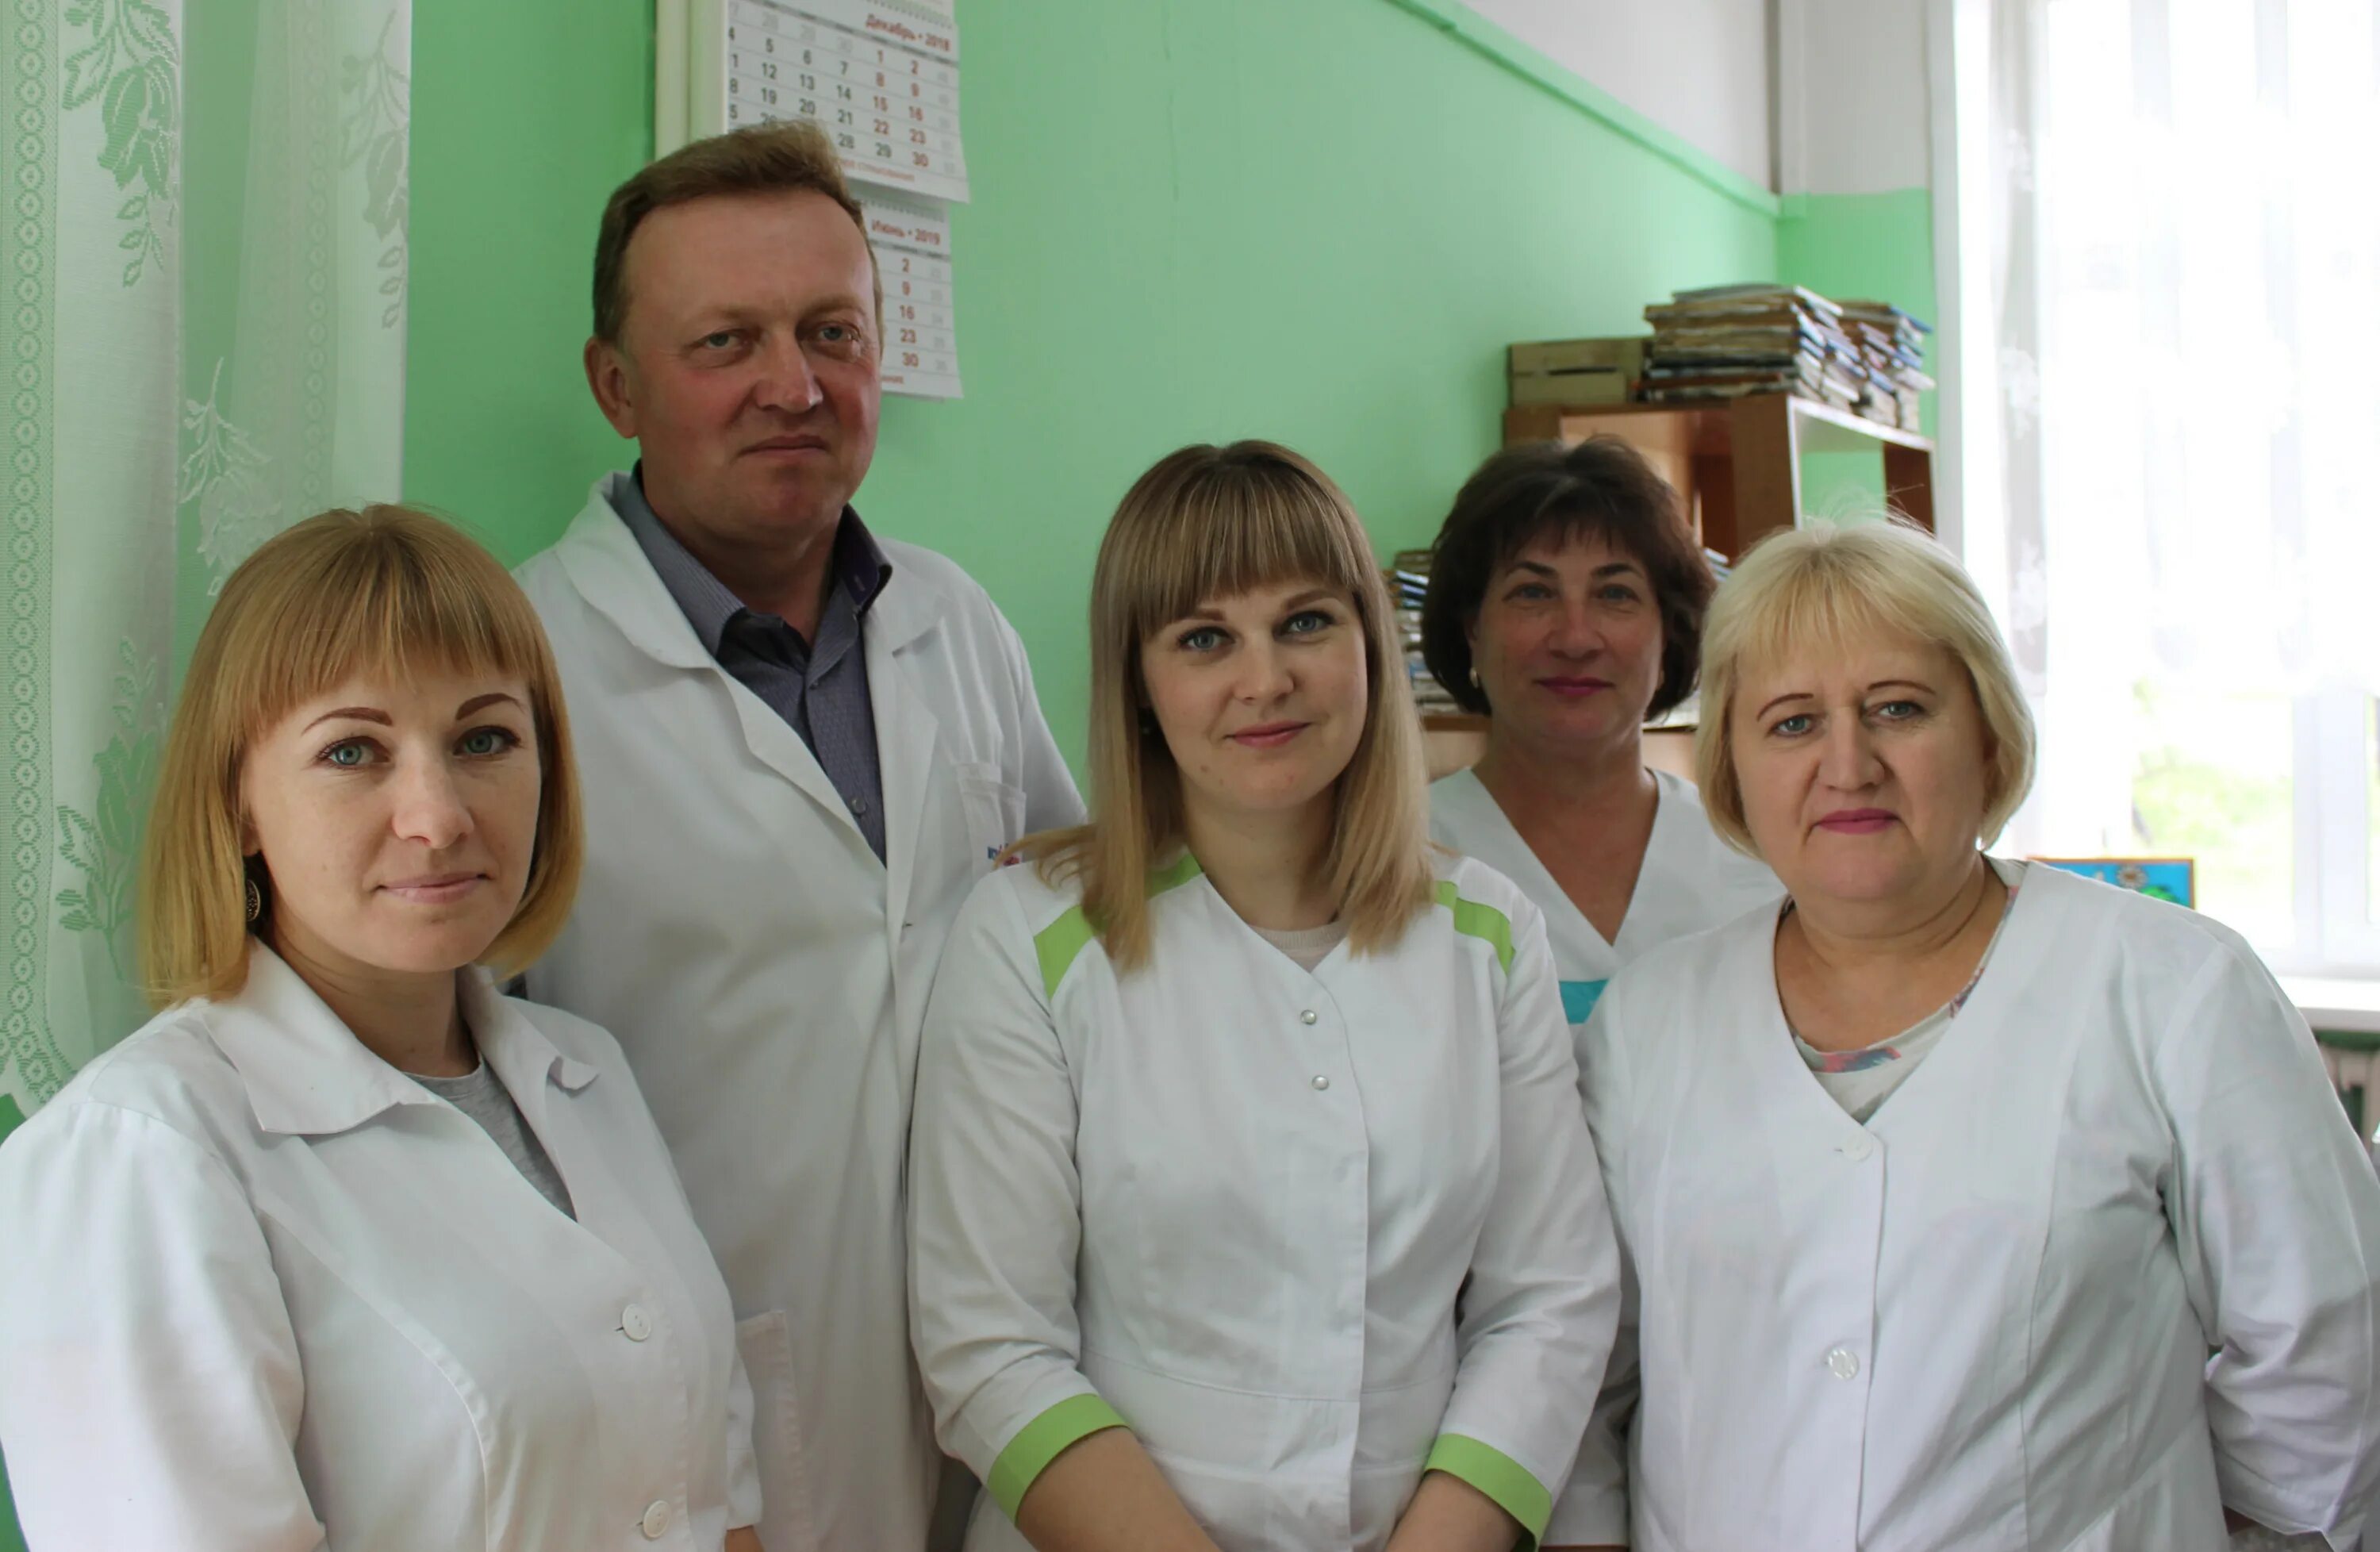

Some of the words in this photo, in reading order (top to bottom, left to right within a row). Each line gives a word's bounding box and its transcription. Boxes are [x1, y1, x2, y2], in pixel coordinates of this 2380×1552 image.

[866, 13, 916, 40] Декабрь
[926, 32, 951, 52] 2018
[728, 26, 735, 40] 4
[766, 38, 774, 53] 5
[803, 49, 812, 65] 6
[839, 61, 848, 75] 7
[876, 71, 885, 88] 8
[911, 83, 919, 98] 9
[877, 49, 885, 63] 1
[911, 60, 919, 75] 2
[762, 62, 777, 79] 12
[800, 74, 816, 90] 13
[837, 84, 852, 101] 14
[873, 95, 889, 113] 15
[909, 106, 923, 122] 16
[761, 87, 777, 105] 19
[799, 98, 816, 116] 20
[837, 109, 854, 125] 21
[873, 118, 889, 136] 22
[910, 128, 927, 145] 23
[838, 133, 855, 149] 28
[875, 141, 892, 159] 29
[912, 152, 929, 167] 30
[871, 218, 905, 237] Июнь
[915, 228, 941, 246] 2019
[902, 258, 910, 273] 2
[902, 281, 911, 297] 9
[899, 305, 915, 321] 16
[900, 328, 917, 344] 23
[902, 352, 919, 368] 30
